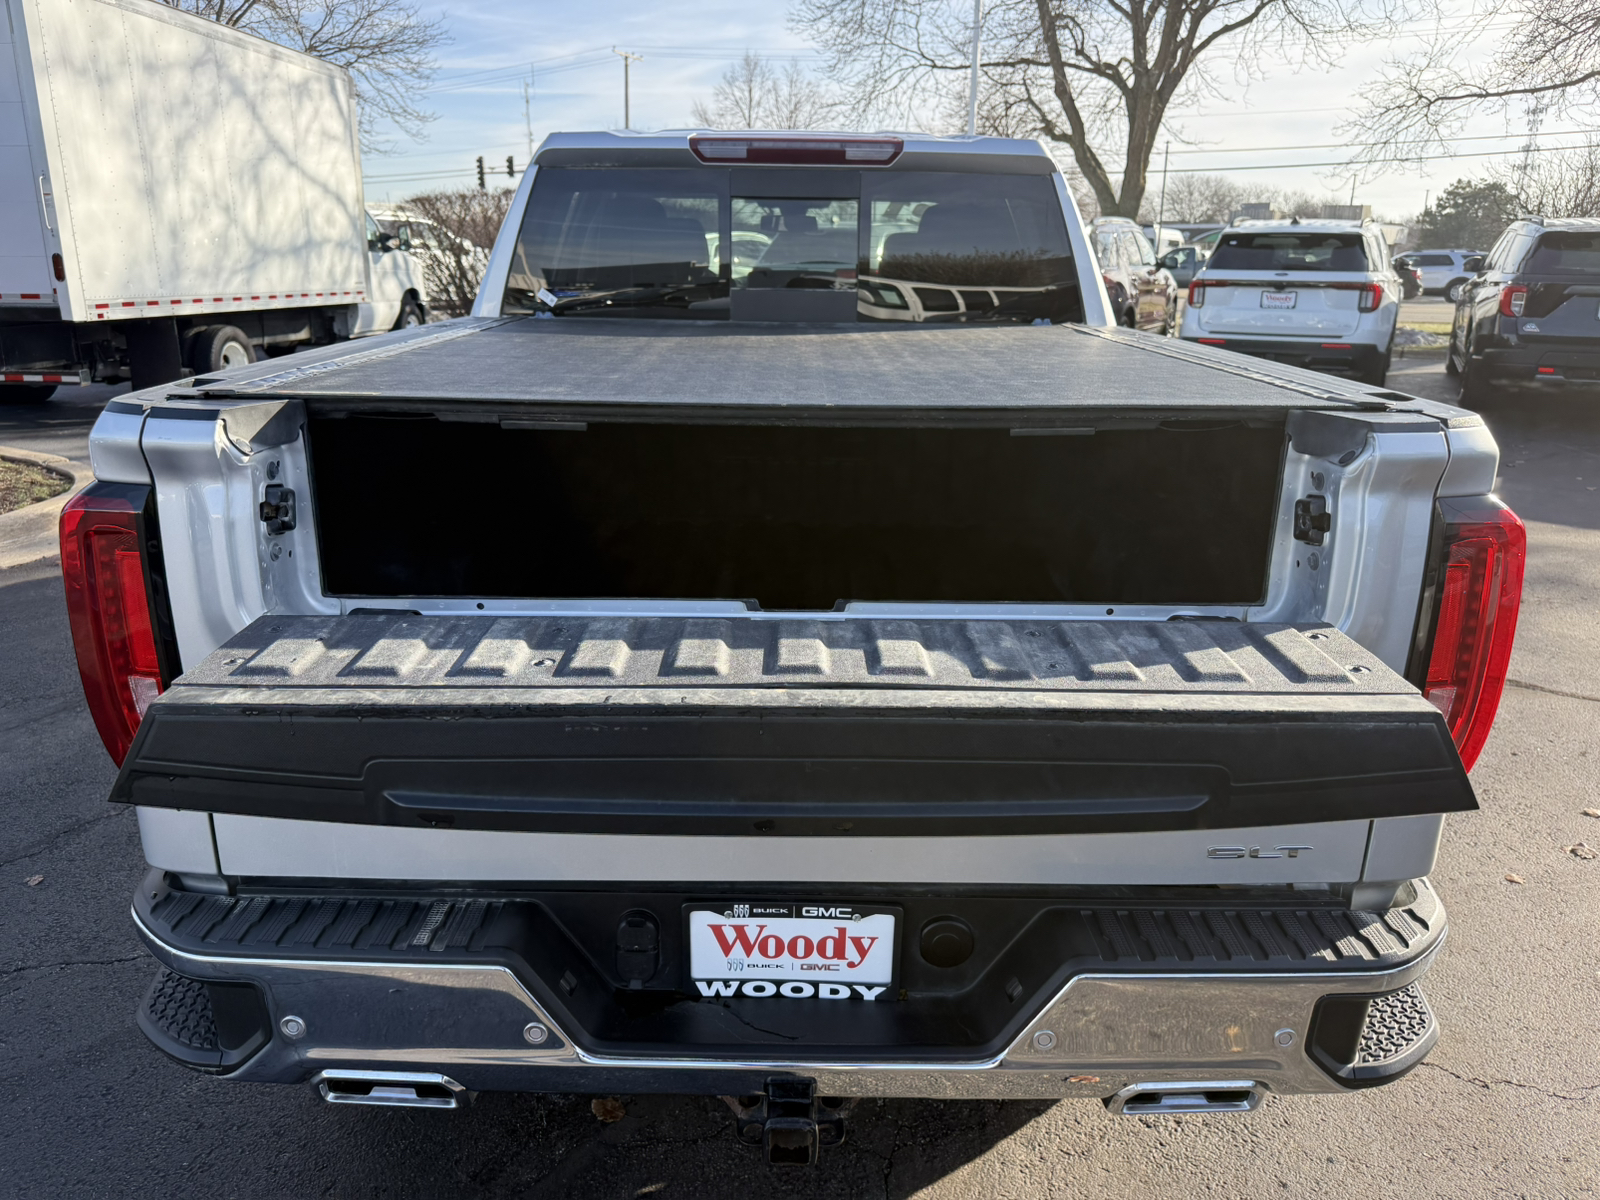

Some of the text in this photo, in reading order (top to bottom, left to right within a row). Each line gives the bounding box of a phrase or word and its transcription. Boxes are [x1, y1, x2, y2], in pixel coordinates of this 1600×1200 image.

[1207, 844, 1314, 859] SLT
[802, 906, 853, 918] GMC
[707, 924, 879, 968] Woody
[800, 963, 840, 972] GMC
[695, 981, 887, 1001] WOODY
